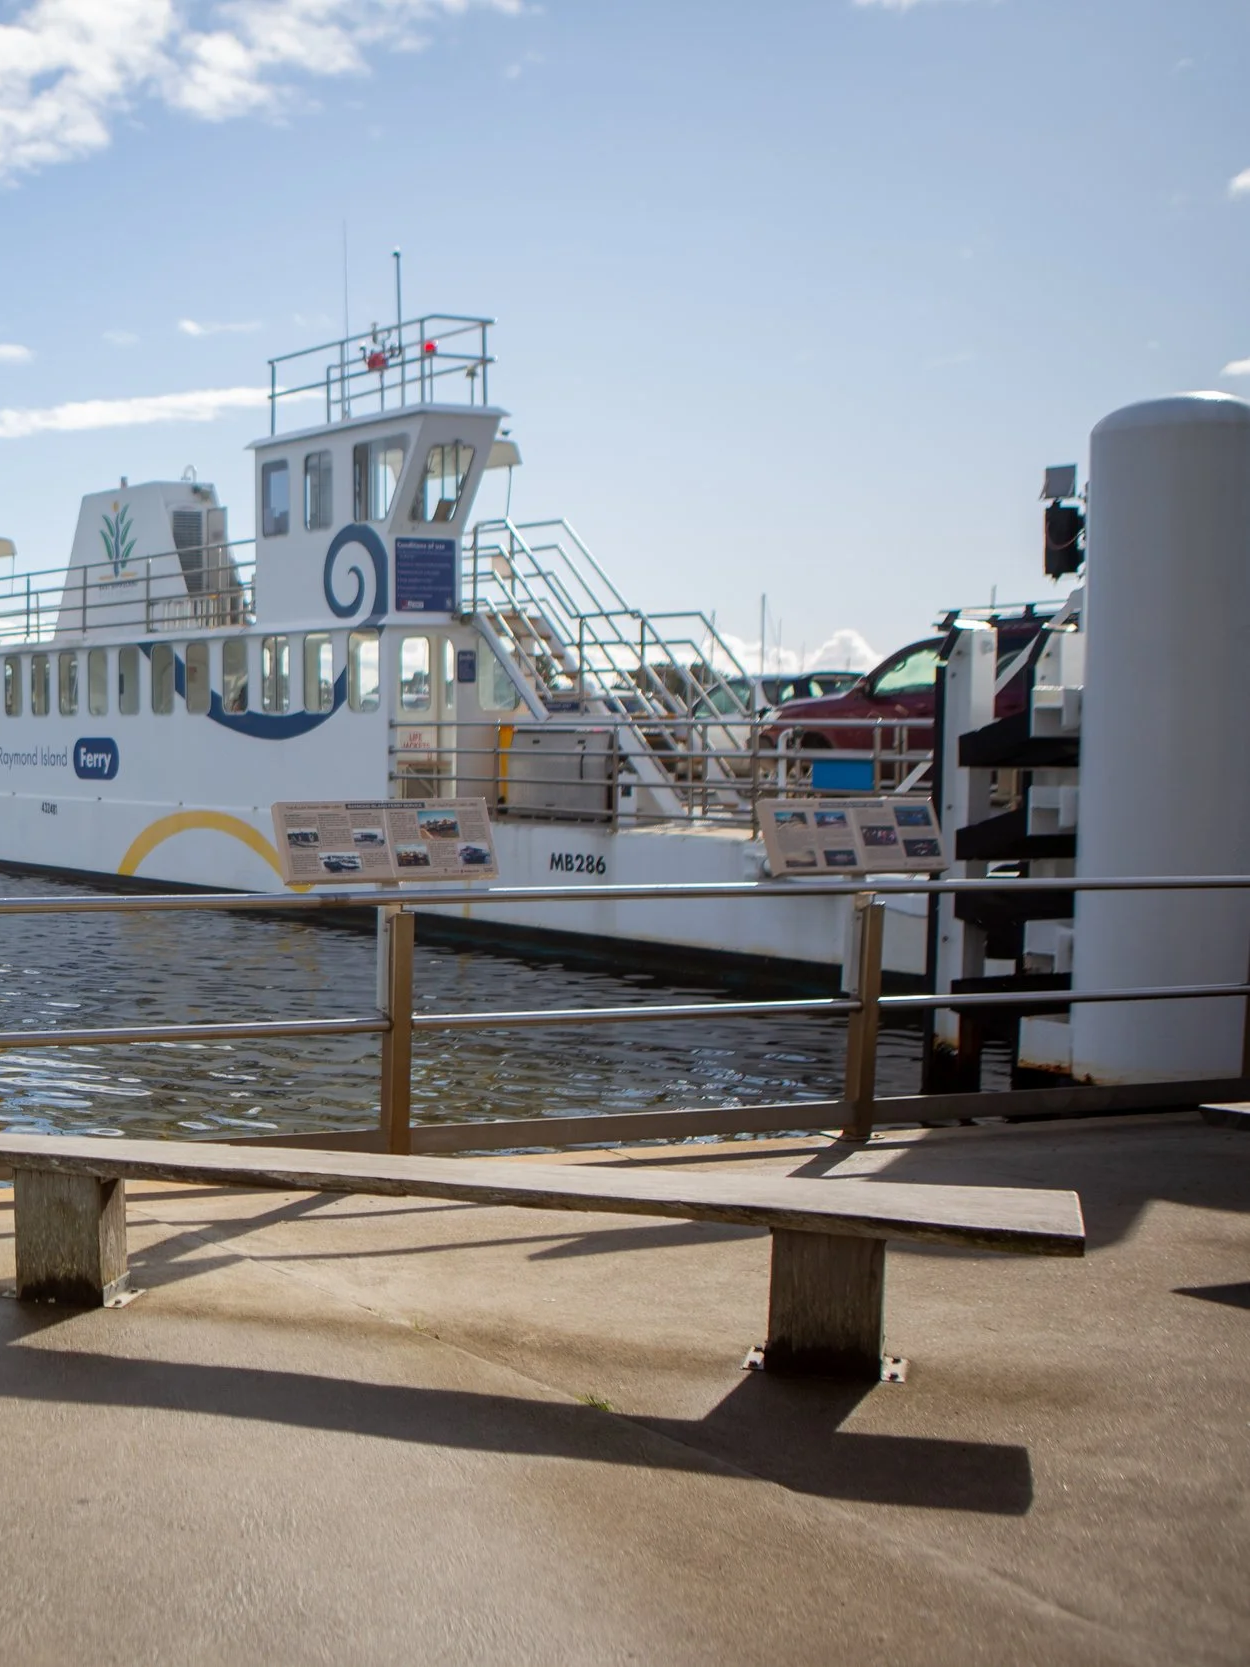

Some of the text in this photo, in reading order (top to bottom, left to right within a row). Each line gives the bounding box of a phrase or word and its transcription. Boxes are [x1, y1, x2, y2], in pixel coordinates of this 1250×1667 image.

[41, 746, 68, 767] Island
[79, 746, 112, 774] Ferry
[549, 852, 606, 875] MB286
